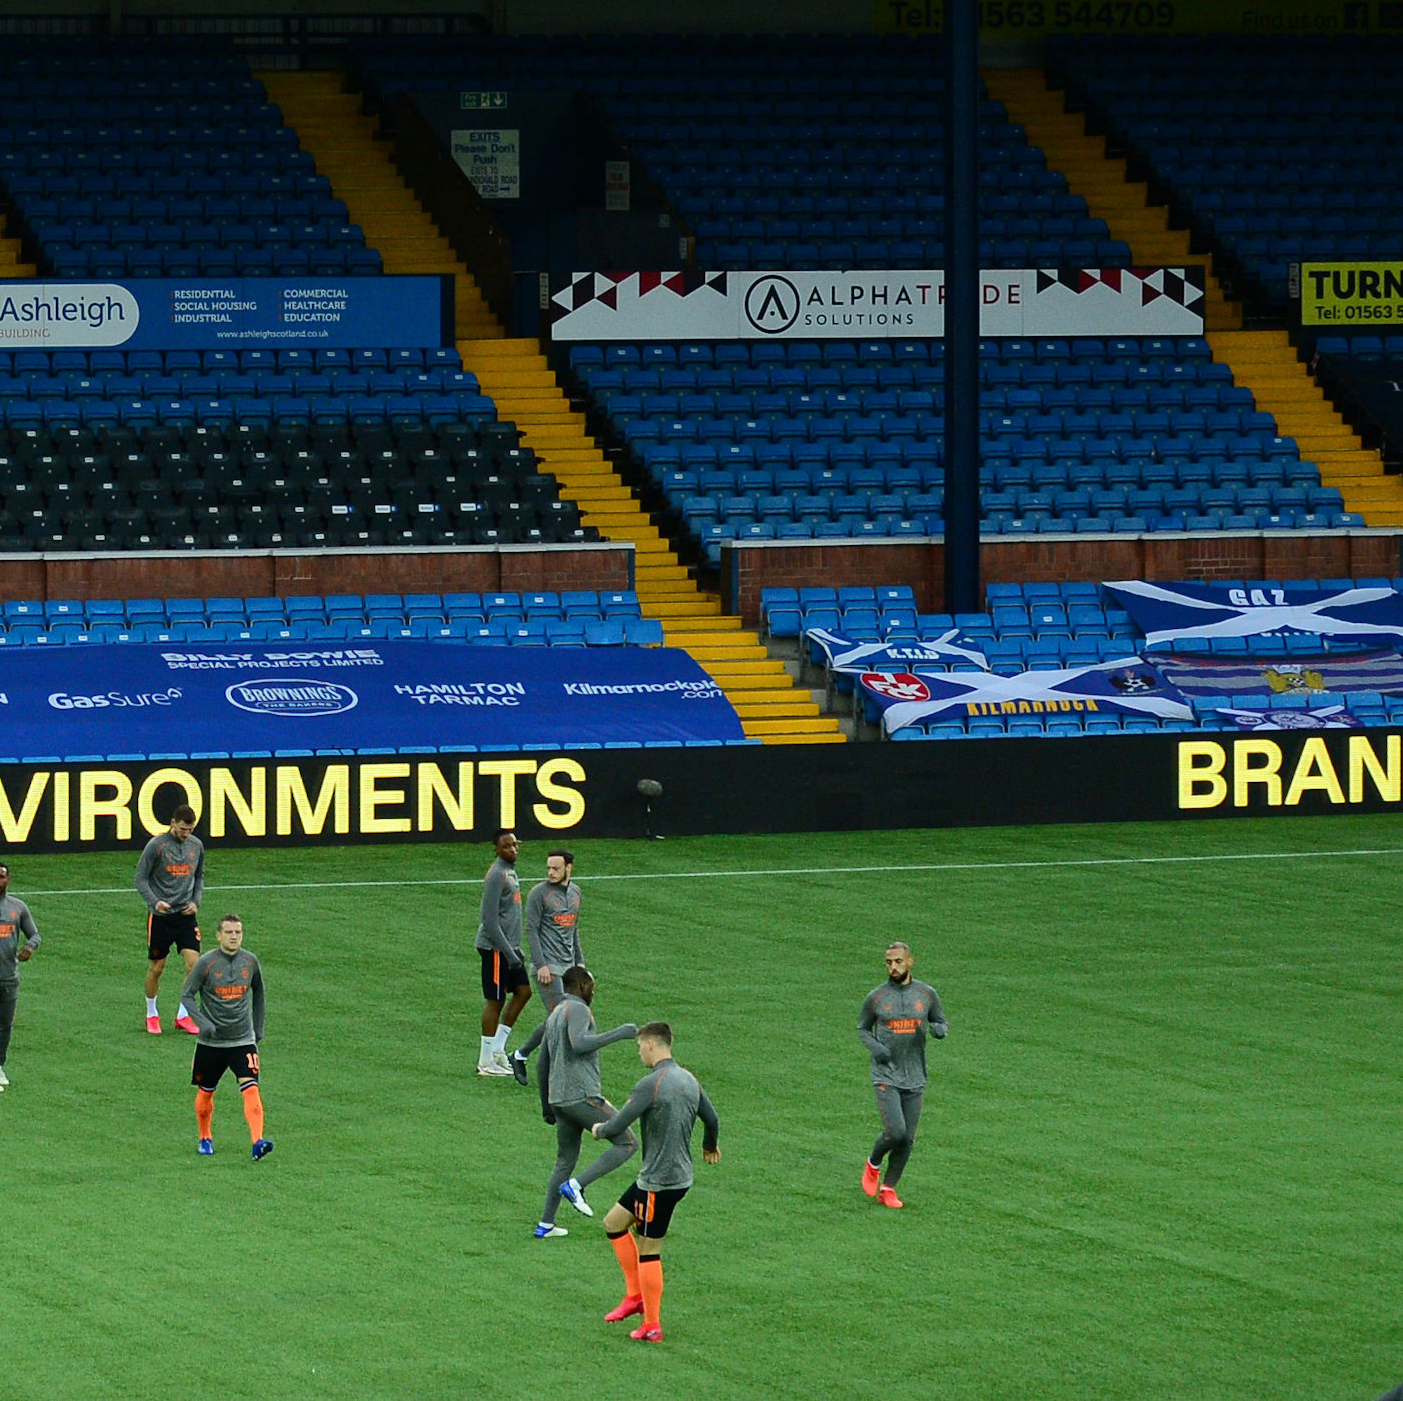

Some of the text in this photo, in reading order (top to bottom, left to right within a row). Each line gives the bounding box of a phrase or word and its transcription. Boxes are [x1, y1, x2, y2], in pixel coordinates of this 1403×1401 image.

[890, 1, 1175, 28] Tel: 544709
[470, 132, 500, 142] EXITS
[455, 144, 515, 153] Please Don't
[474, 155, 497, 164] Push
[174, 290, 236, 299] RESIDENTIAL
[284, 289, 348, 298] COMMERCIAL
[174, 302, 257, 311] SOCIAL HOUSING
[284, 301, 346, 310] HEALTHCARE
[0, 296, 124, 327] Ashleigh
[1315, 305, 1393, 319] Tel: 01563
[174, 314, 232, 323] INDUSTRIAL
[284, 313, 340, 322] EDUCATION
[805, 314, 914, 325] SOLUTIONS
[217, 330, 329, 339] www.ashleighscotland.co.uk
[1228, 589, 1289, 606] GAZ
[161, 650, 381, 662] BILLY BOWIE
[168, 659, 384, 669] SPECIAL PROJECTS LIMITED
[240, 686, 342, 702] BROWNINGS
[394, 682, 526, 696] HAMILTON
[48, 691, 172, 709] GasSure
[411, 695, 520, 706] TARMAC
[1179, 735, 1401, 809] BRAN
